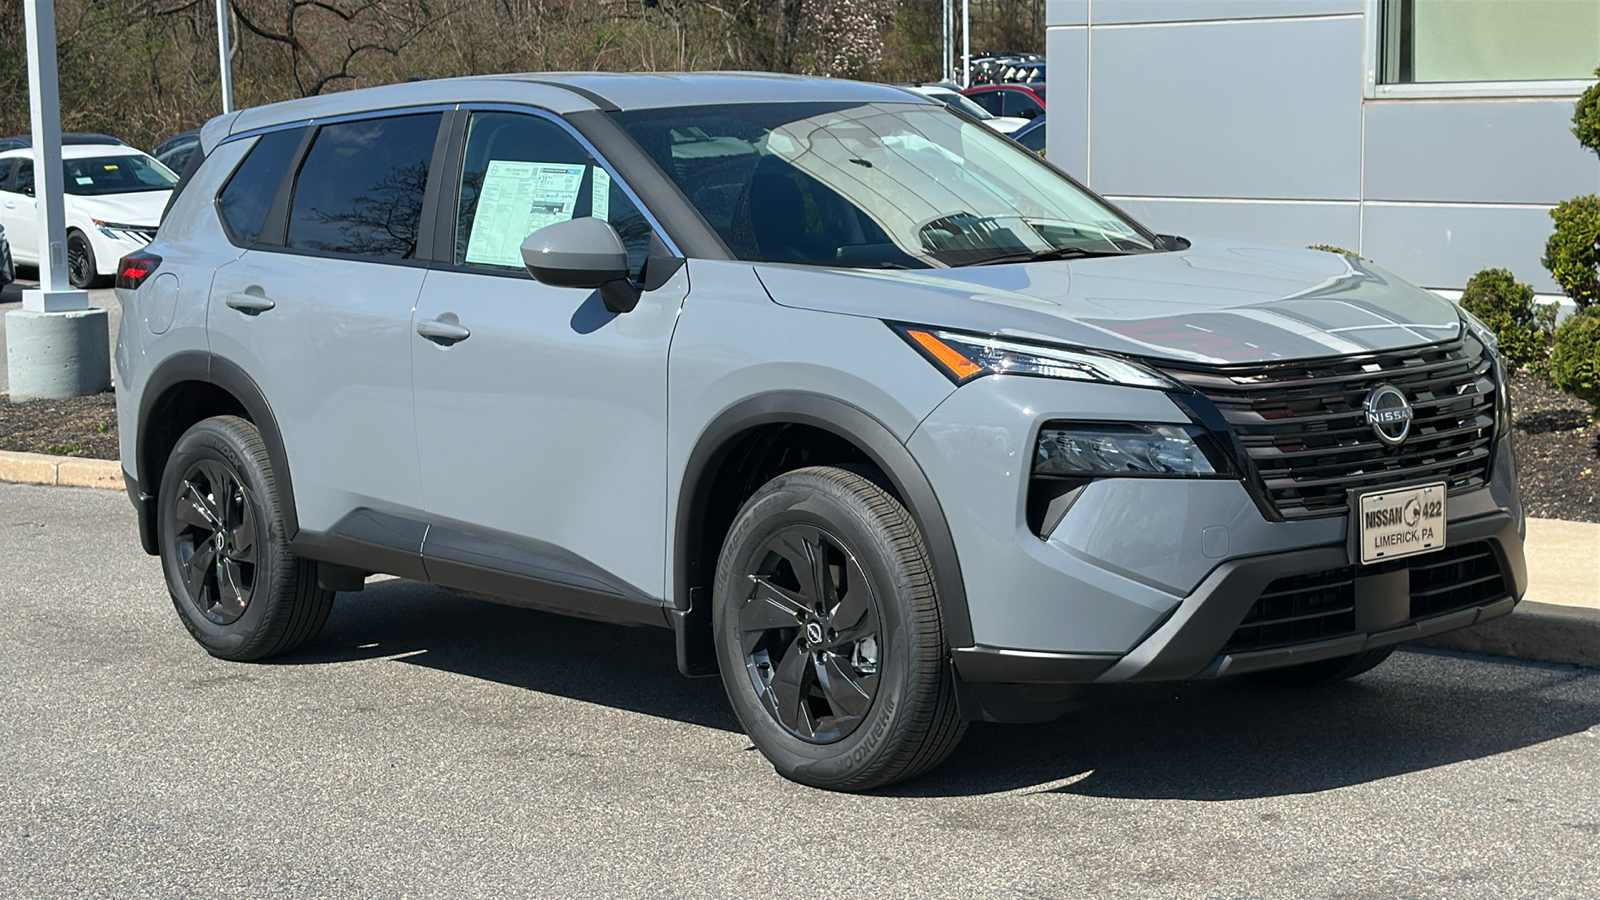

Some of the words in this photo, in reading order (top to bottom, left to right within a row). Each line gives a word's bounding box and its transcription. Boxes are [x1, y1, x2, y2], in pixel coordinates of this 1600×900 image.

[1369, 409, 1412, 423] NISSAN
[1365, 506, 1403, 529] NISSAN
[1422, 501, 1442, 520] 422
[1374, 530, 1420, 548] LIMERICK,
[1421, 527, 1434, 540] PA
